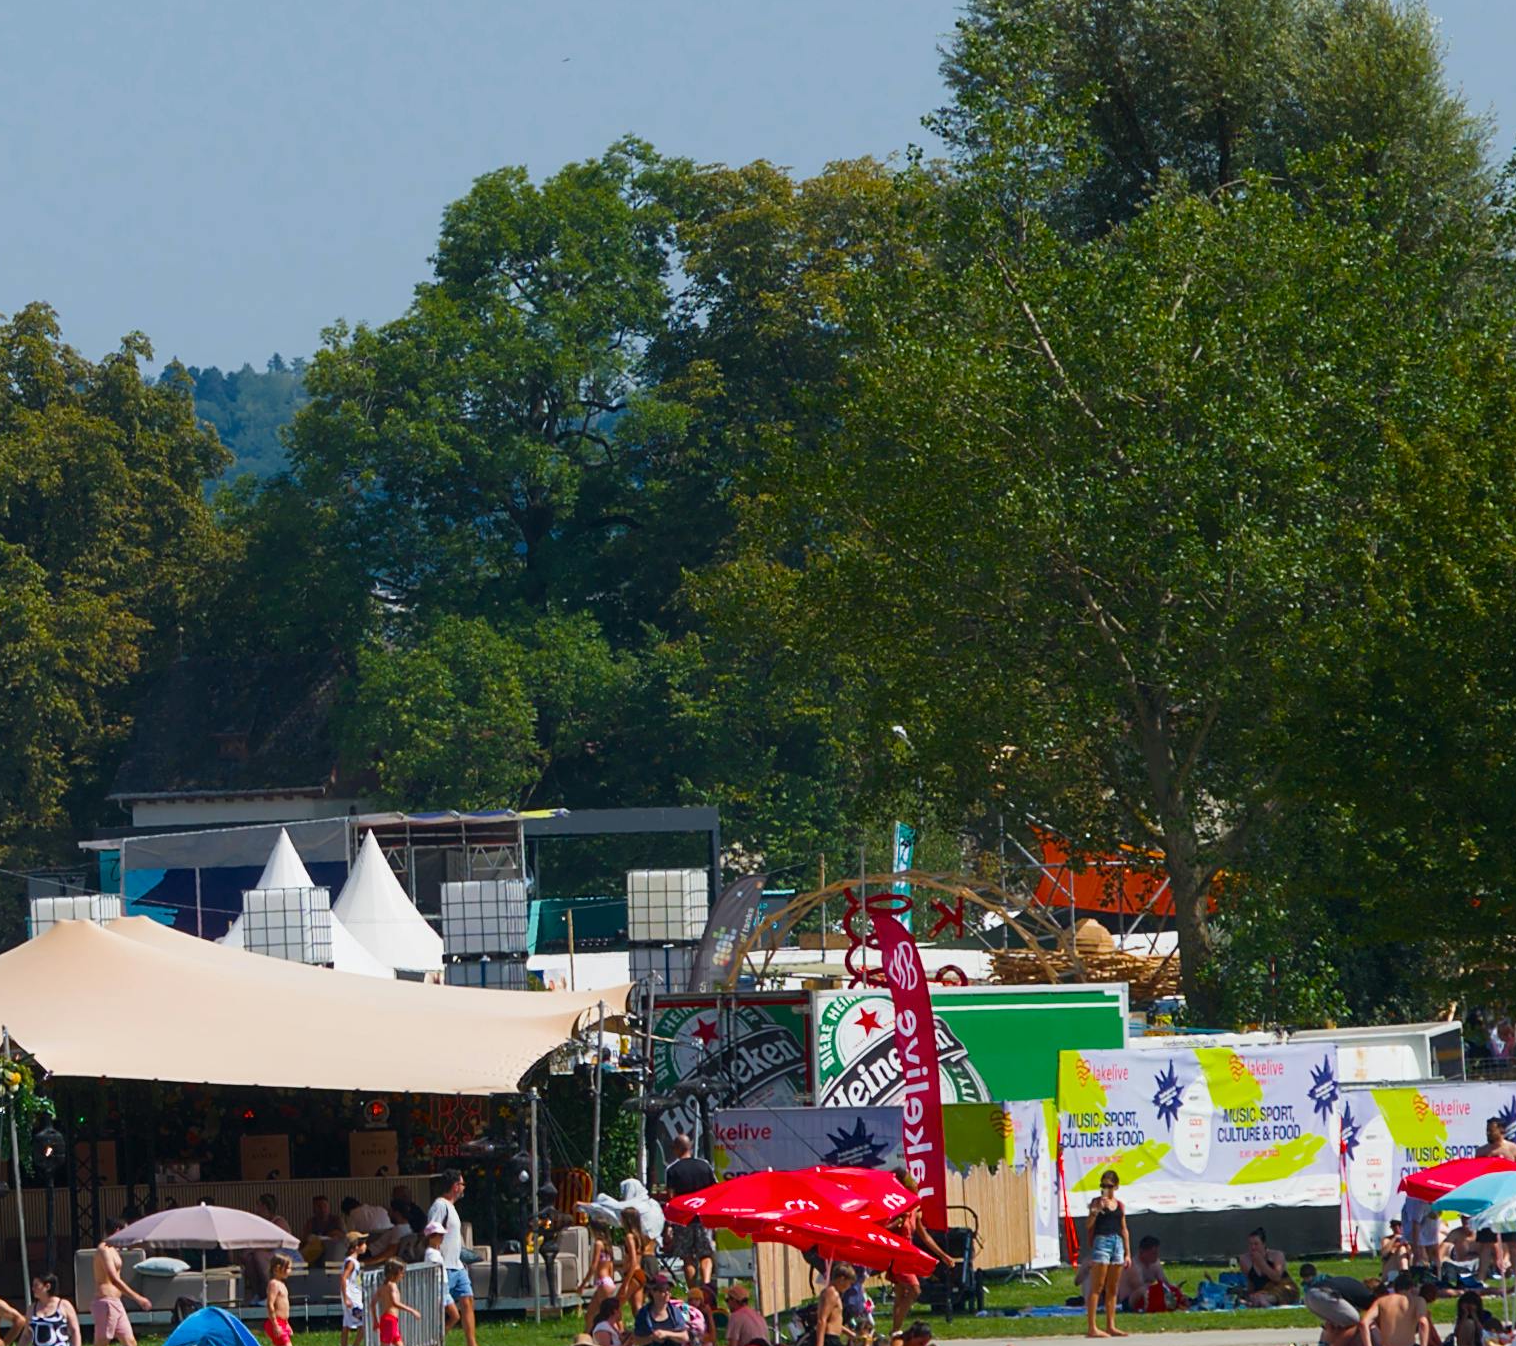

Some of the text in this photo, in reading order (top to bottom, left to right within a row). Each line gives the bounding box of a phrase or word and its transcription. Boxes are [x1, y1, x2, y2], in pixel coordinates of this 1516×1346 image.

[1092, 1064, 1129, 1082] lakelive
[1248, 1059, 1284, 1076] lakelive
[897, 1008, 935, 1201] lakelive
[1431, 1100, 1471, 1116] lakelive
[1068, 1110, 1139, 1129] MUSIC, SPORT,
[1222, 1107, 1258, 1123] MUSIC,
[1258, 1105, 1295, 1123] SPORT,
[1062, 1130, 1145, 1149] CULTURE & FOOD
[1218, 1123, 1301, 1143] CULTURE & FOOD
[1405, 1146, 1443, 1163] MUSIC,
